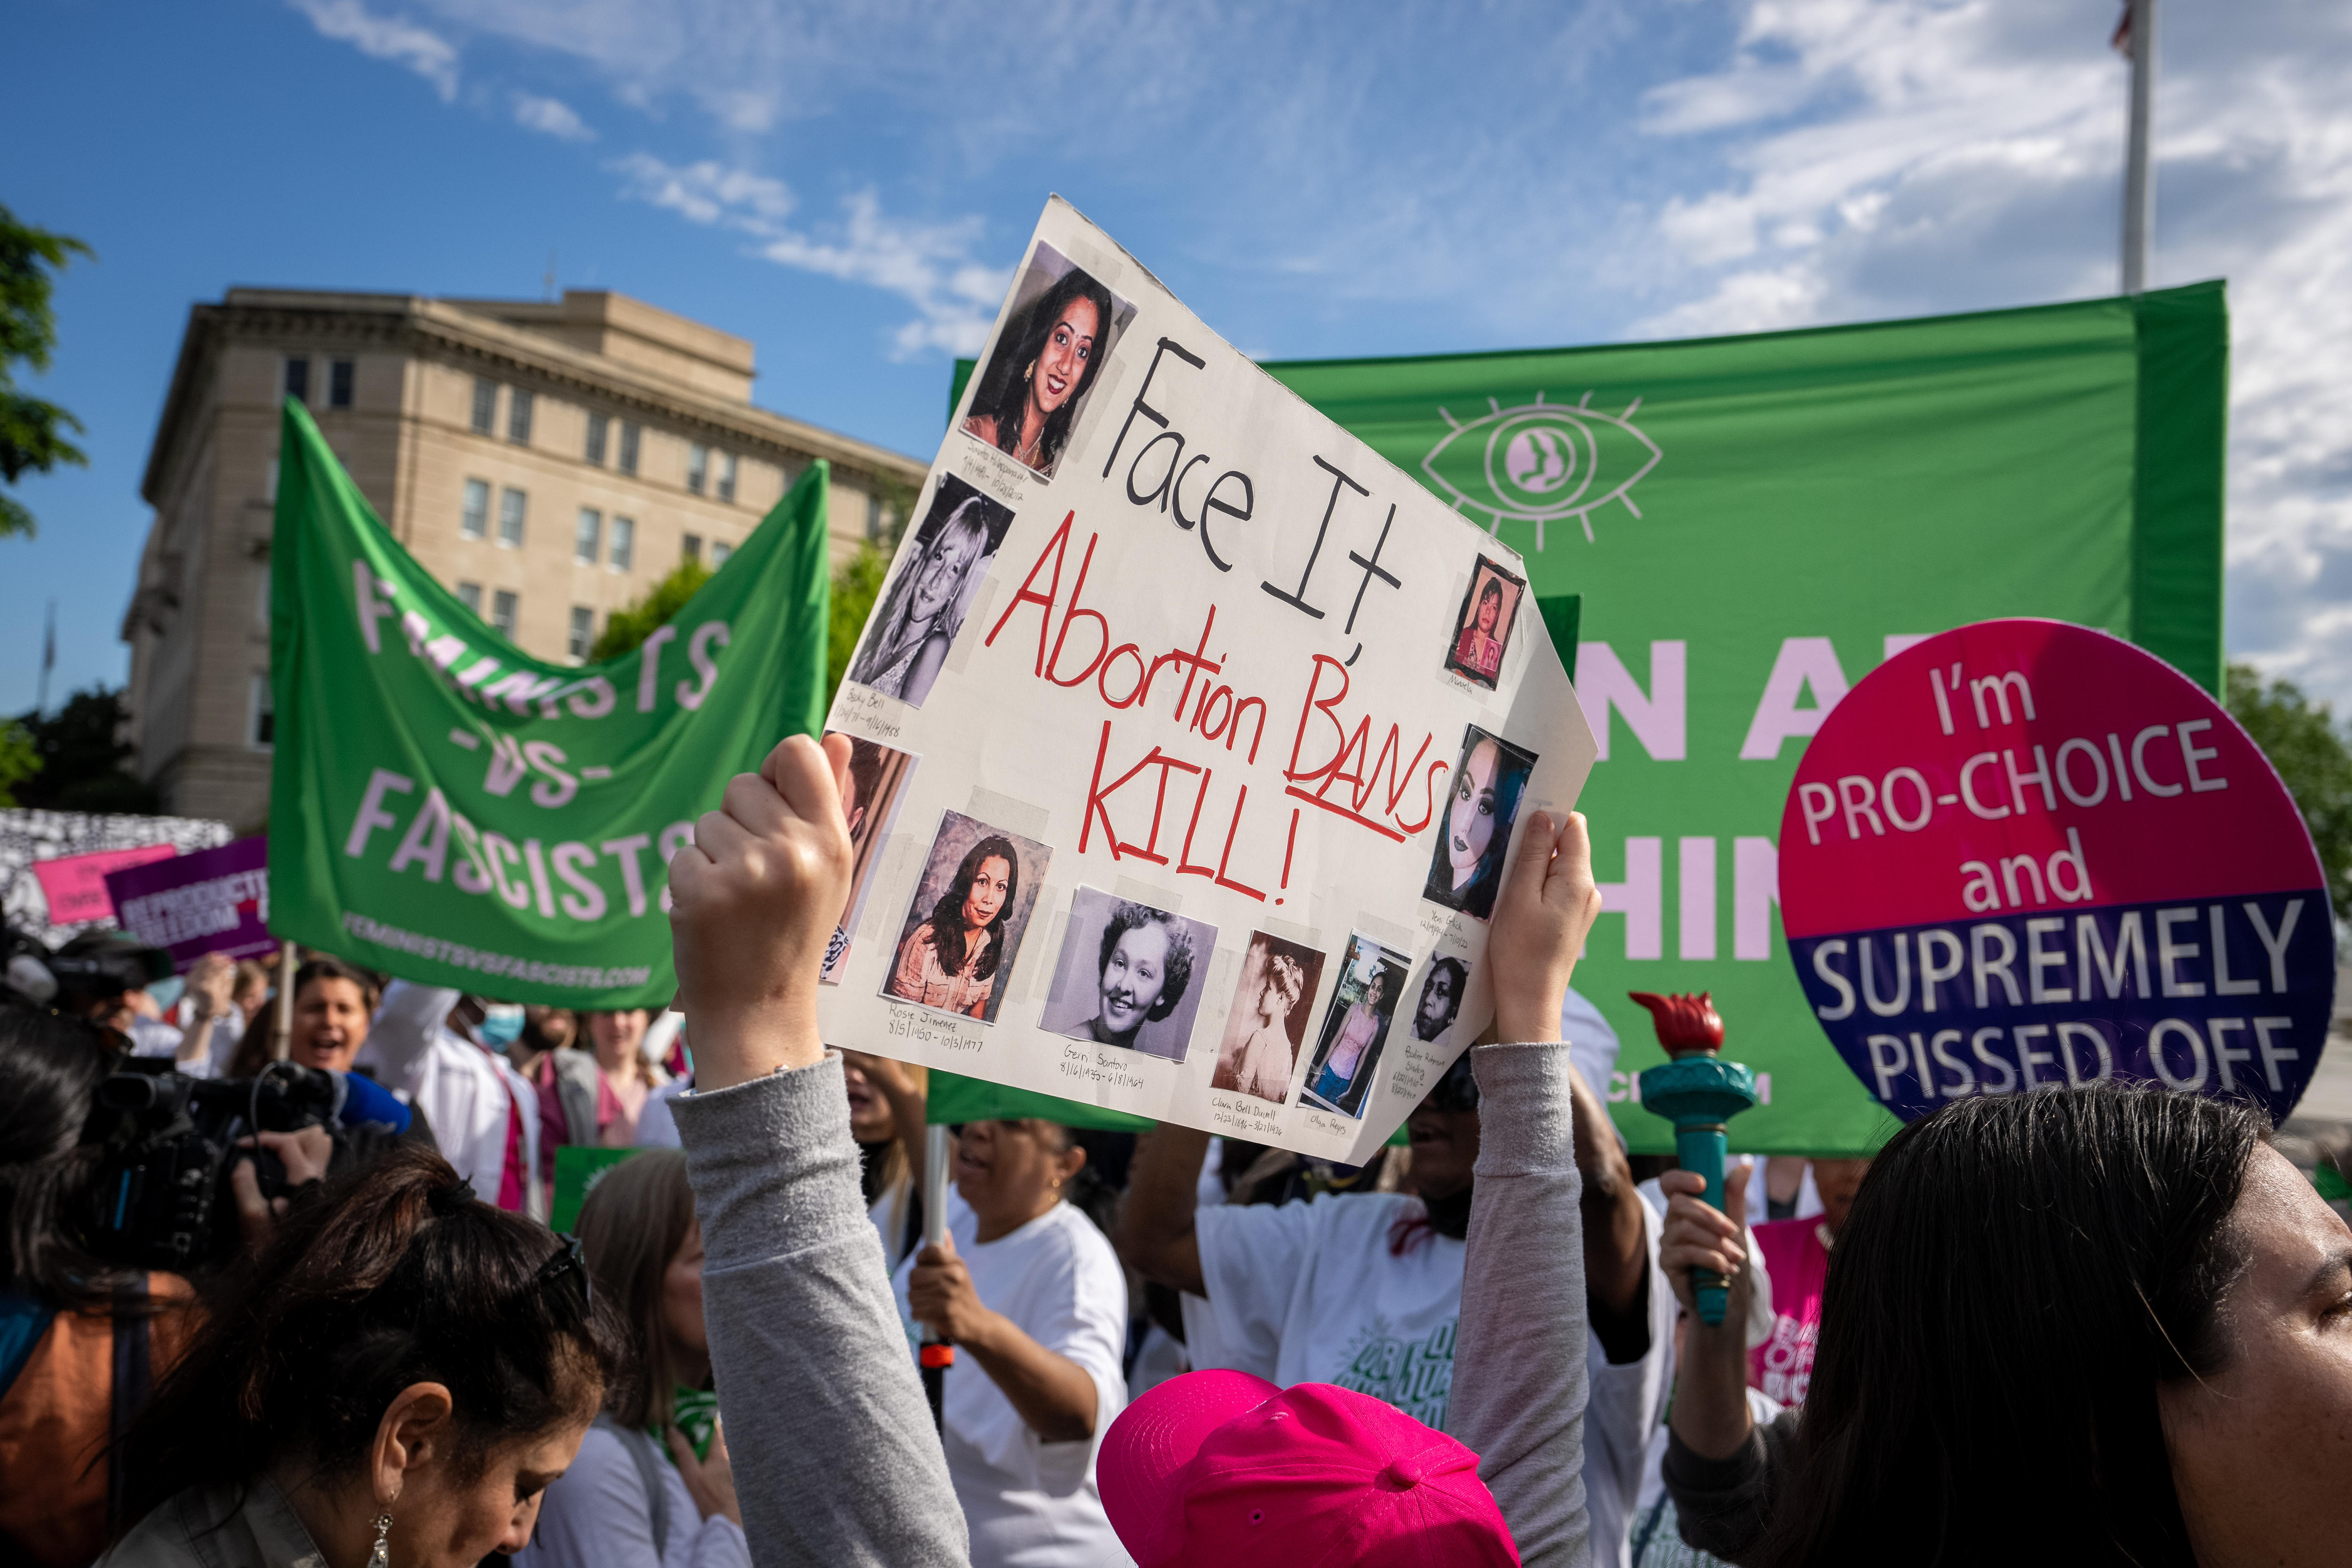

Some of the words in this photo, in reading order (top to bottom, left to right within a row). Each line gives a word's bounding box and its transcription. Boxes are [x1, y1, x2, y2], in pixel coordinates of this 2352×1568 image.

[1103, 336, 1255, 572] Face
[866, 692, 885, 709] Bell
[985, 509, 1267, 765] Abortion
[1282, 653, 1449, 834] BANS
[1929, 661, 2037, 737] I'm
[1078, 720, 1300, 906] KILL!
[1797, 717, 2229, 846] PRO-CHOICE
[1958, 826, 2095, 914] and
[1446, 915, 1463, 932] Glick
[1812, 898, 2305, 1022] SUPREMELY
[889, 1002, 914, 1020] Rosie
[920, 1011, 957, 1033] Jimenez
[1064, 1044, 1090, 1063] Gerri
[1097, 1053, 1128, 1071] Santoro
[1867, 1021, 2114, 1102] PISSED
[2147, 1016, 2301, 1094] OFF
[1212, 1097, 1232, 1110] Clara
[1235, 1100, 1251, 1114] Bell
[1310, 1115, 1326, 1129] Olga
